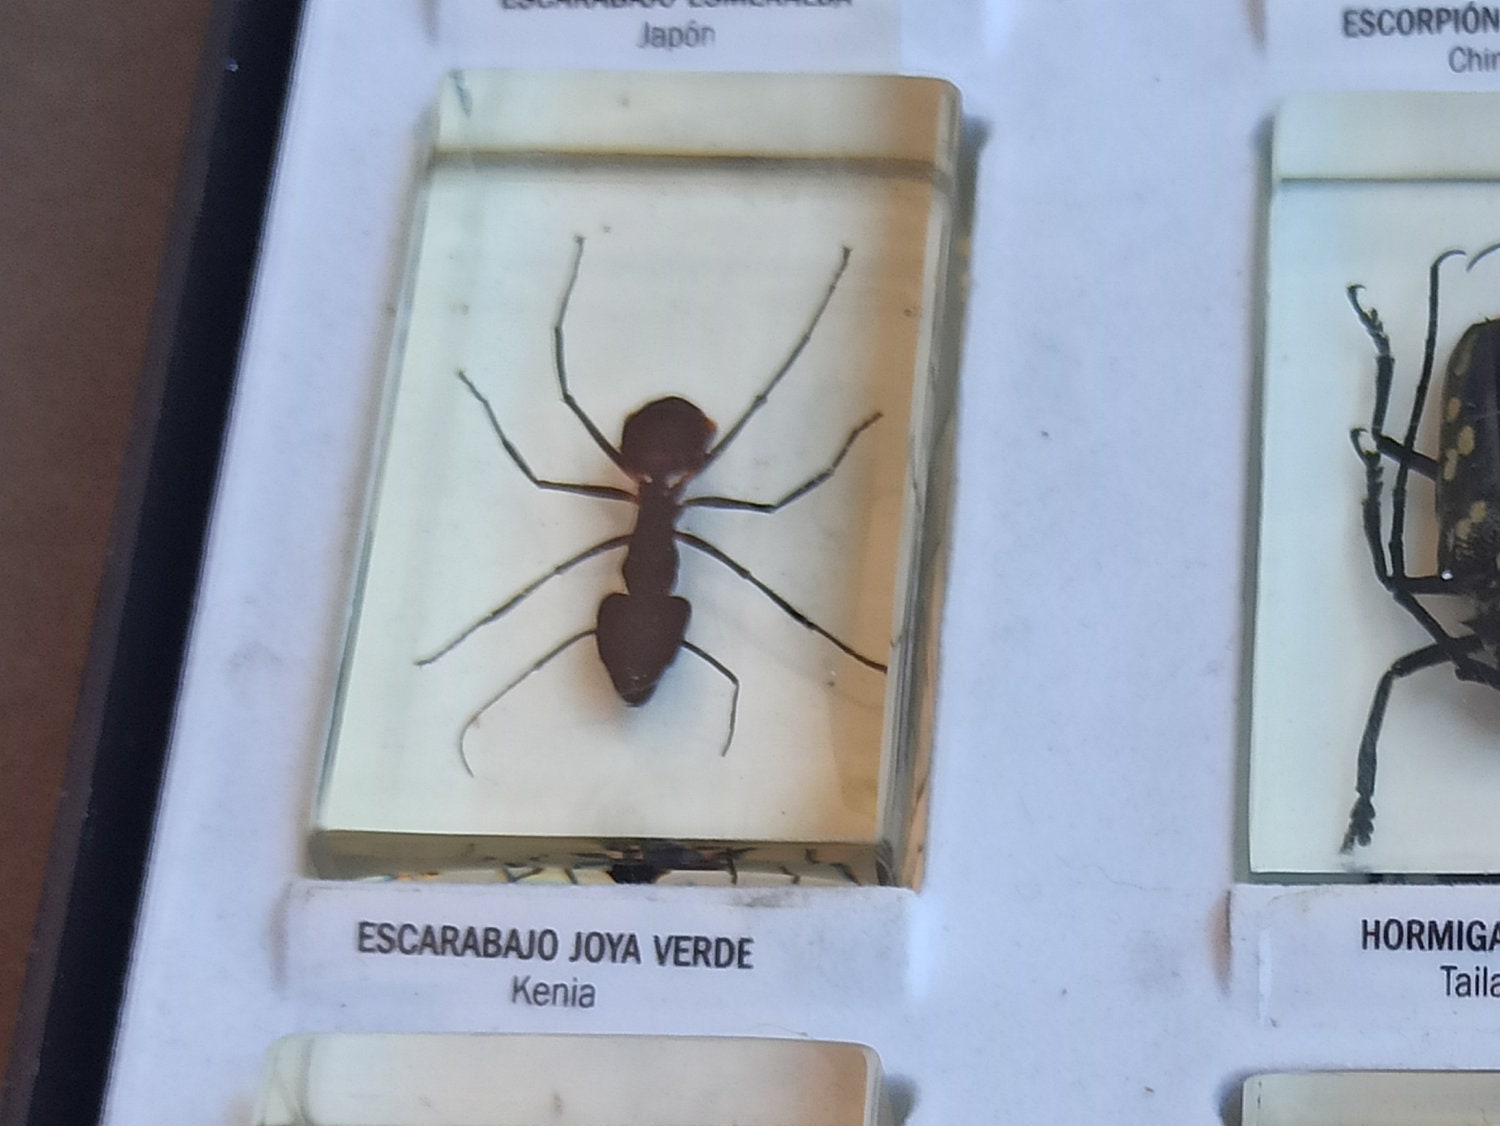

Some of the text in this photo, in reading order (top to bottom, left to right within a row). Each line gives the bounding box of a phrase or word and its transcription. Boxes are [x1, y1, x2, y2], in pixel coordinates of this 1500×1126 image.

[638, 20, 715, 50] Japón
[1342, 1, 1500, 38] ESCORPIÓN
[358, 921, 754, 969] ESCARABAJO JOYA VERDE
[512, 975, 596, 1008] Kenia
